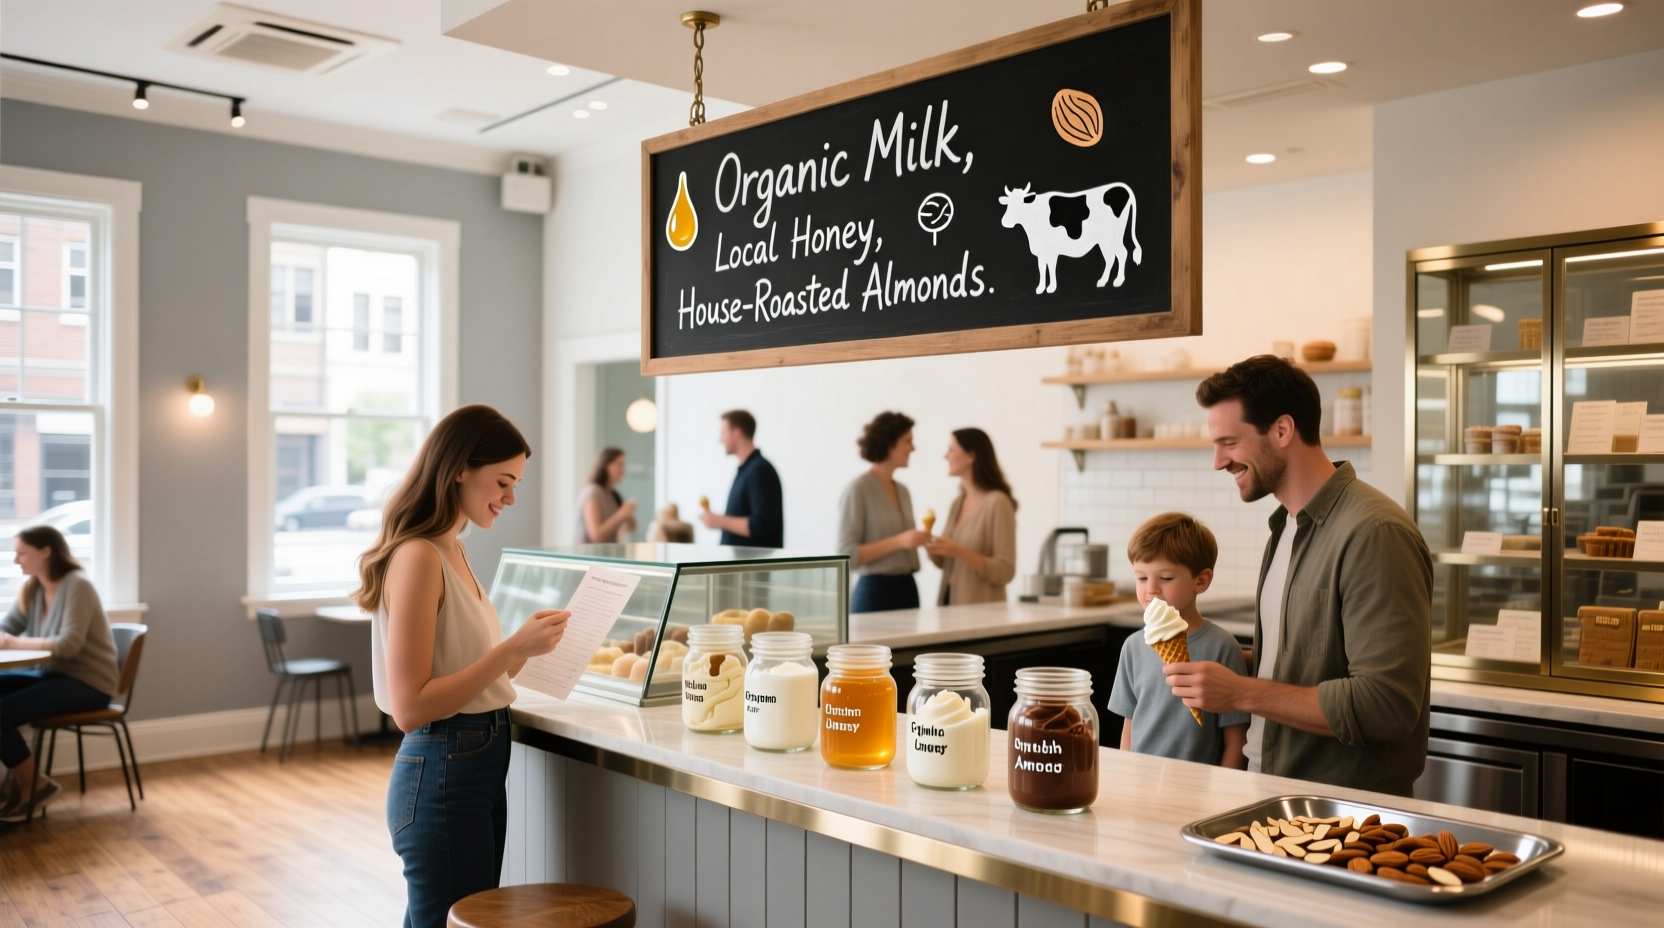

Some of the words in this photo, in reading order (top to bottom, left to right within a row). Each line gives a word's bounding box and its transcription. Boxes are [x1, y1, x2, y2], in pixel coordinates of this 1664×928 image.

[714, 142, 850, 229] Organic
[863, 100, 975, 184] Milk,
[714, 220, 779, 273] Local
[790, 215, 884, 267] Honey,
[677, 265, 851, 331] House-Roasted
[861, 249, 996, 313] Almonds.
